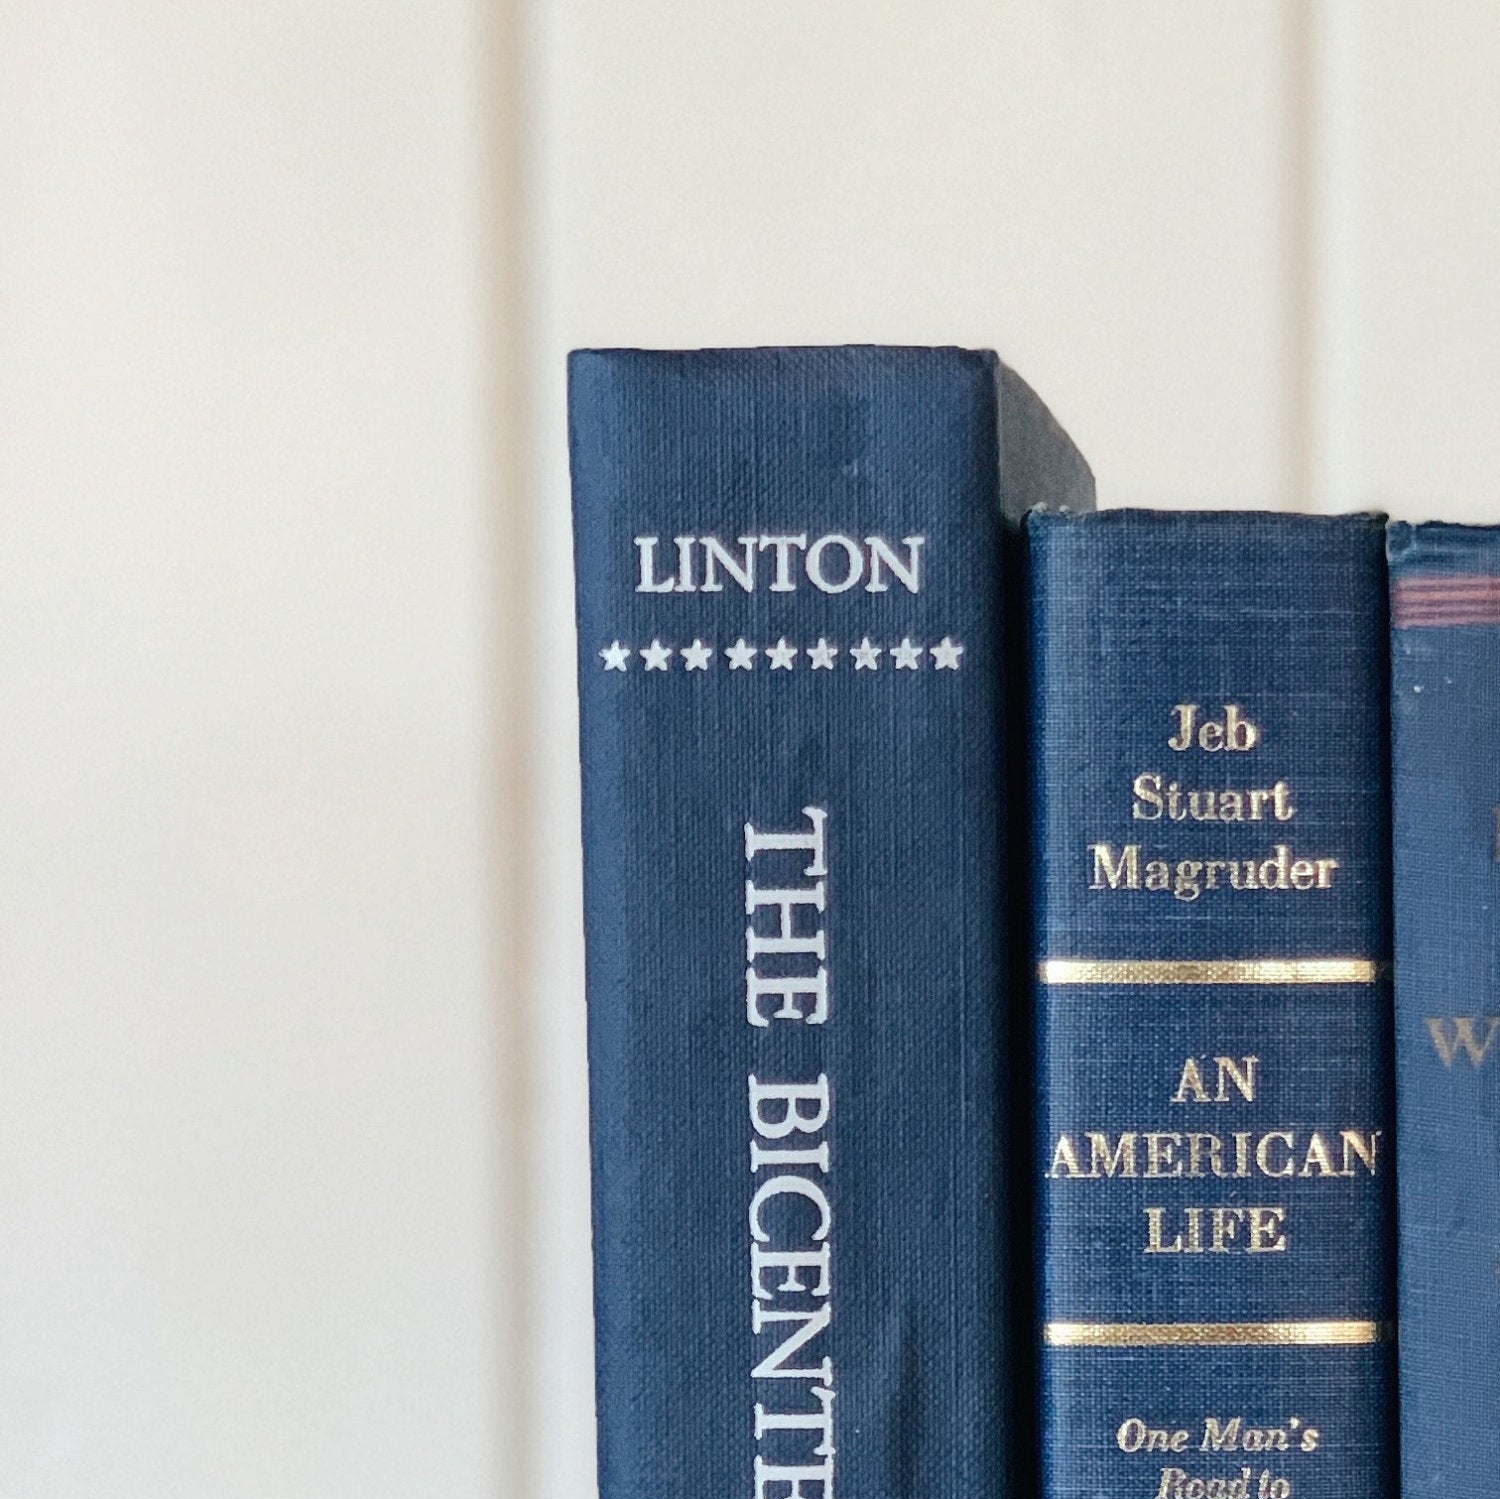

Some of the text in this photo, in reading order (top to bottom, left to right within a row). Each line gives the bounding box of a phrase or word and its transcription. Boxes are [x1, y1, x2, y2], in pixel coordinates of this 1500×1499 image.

[633, 536, 925, 594] LINTON
[1167, 705, 1256, 753] Jeb
[1132, 775, 1294, 822] Stuart
[1088, 844, 1338, 901] Magruder
[744, 806, 828, 1027] THE
[1171, 1056, 1259, 1103] AN
[1044, 1129, 1382, 1178] AMERICAN
[1143, 1206, 1286, 1254] LIFE
[1116, 1416, 1320, 1452] One Man's
